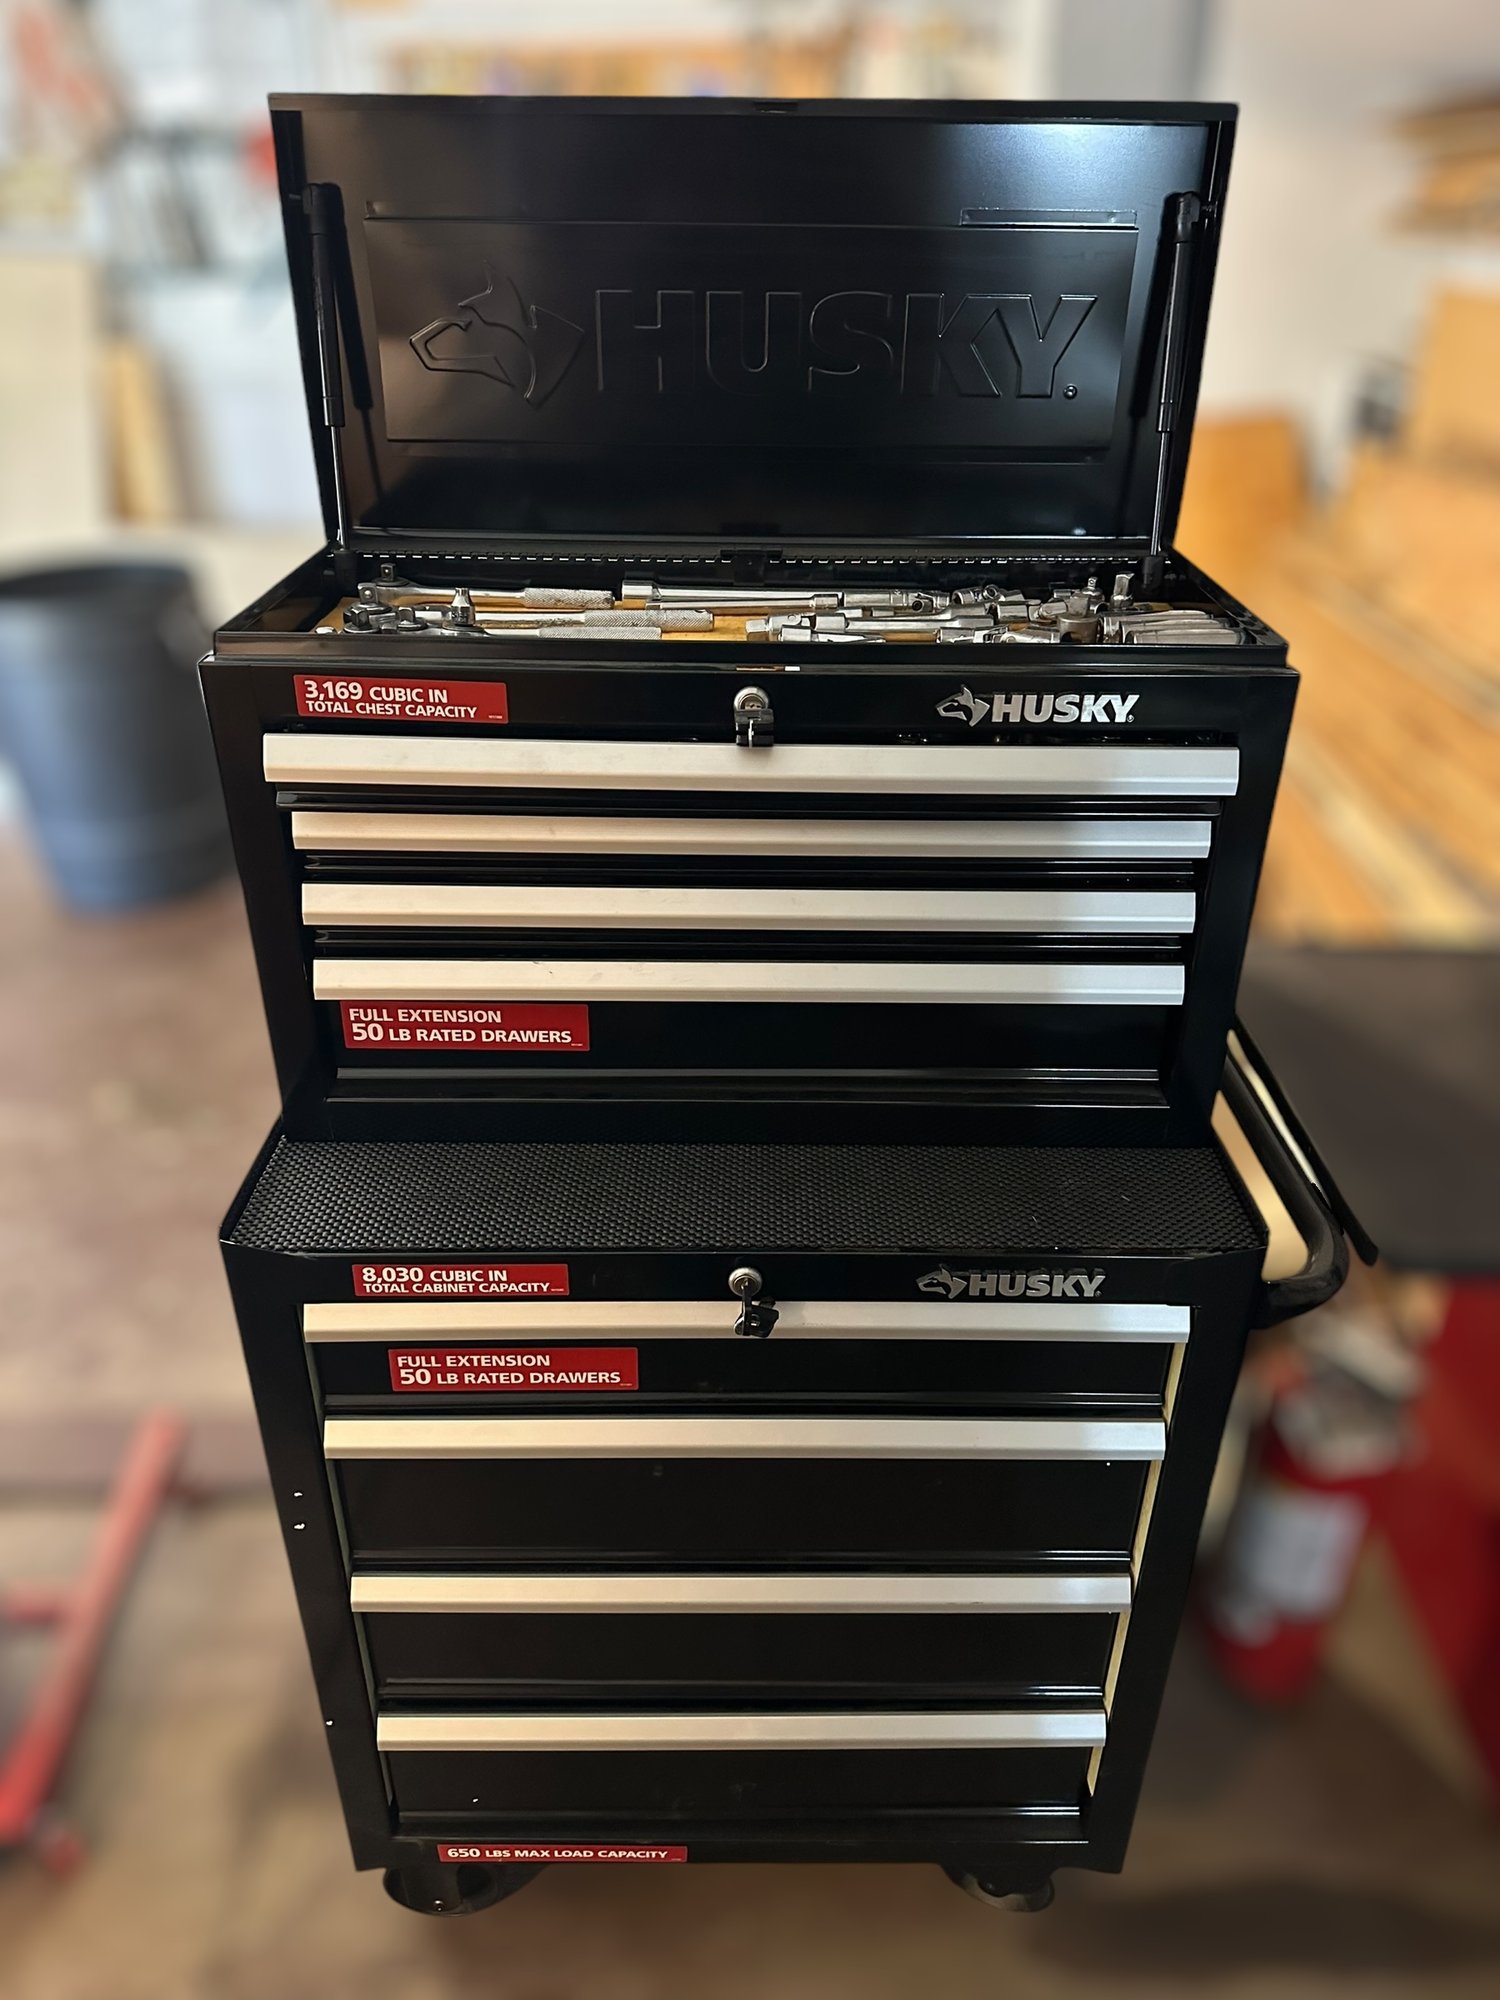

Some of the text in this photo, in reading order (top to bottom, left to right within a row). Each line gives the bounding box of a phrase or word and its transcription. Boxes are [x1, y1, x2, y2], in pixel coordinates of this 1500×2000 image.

[595, 290, 1098, 398] HUSKY
[304, 680, 448, 704] 3,169 CUBIC IN
[305, 700, 477, 719] TOTAL CHEST CAPACITY
[991, 694, 1140, 723] HUSKY
[349, 1008, 502, 1023] FULL EXTENSION
[351, 1023, 572, 1044] 50 LB RATED DRAWERS
[362, 1267, 507, 1284] 8,030 CUBIC IN
[363, 1282, 550, 1293] TOTAL CABINET CAPACITY
[969, 1273, 1106, 1297] HUSKY
[397, 1355, 550, 1367] FULL EXTENSION
[400, 1369, 621, 1385] 50 LB RATED DRAWERS
[448, 1848, 668, 1859] 650 LBS MAX LOAD CAPACITY
